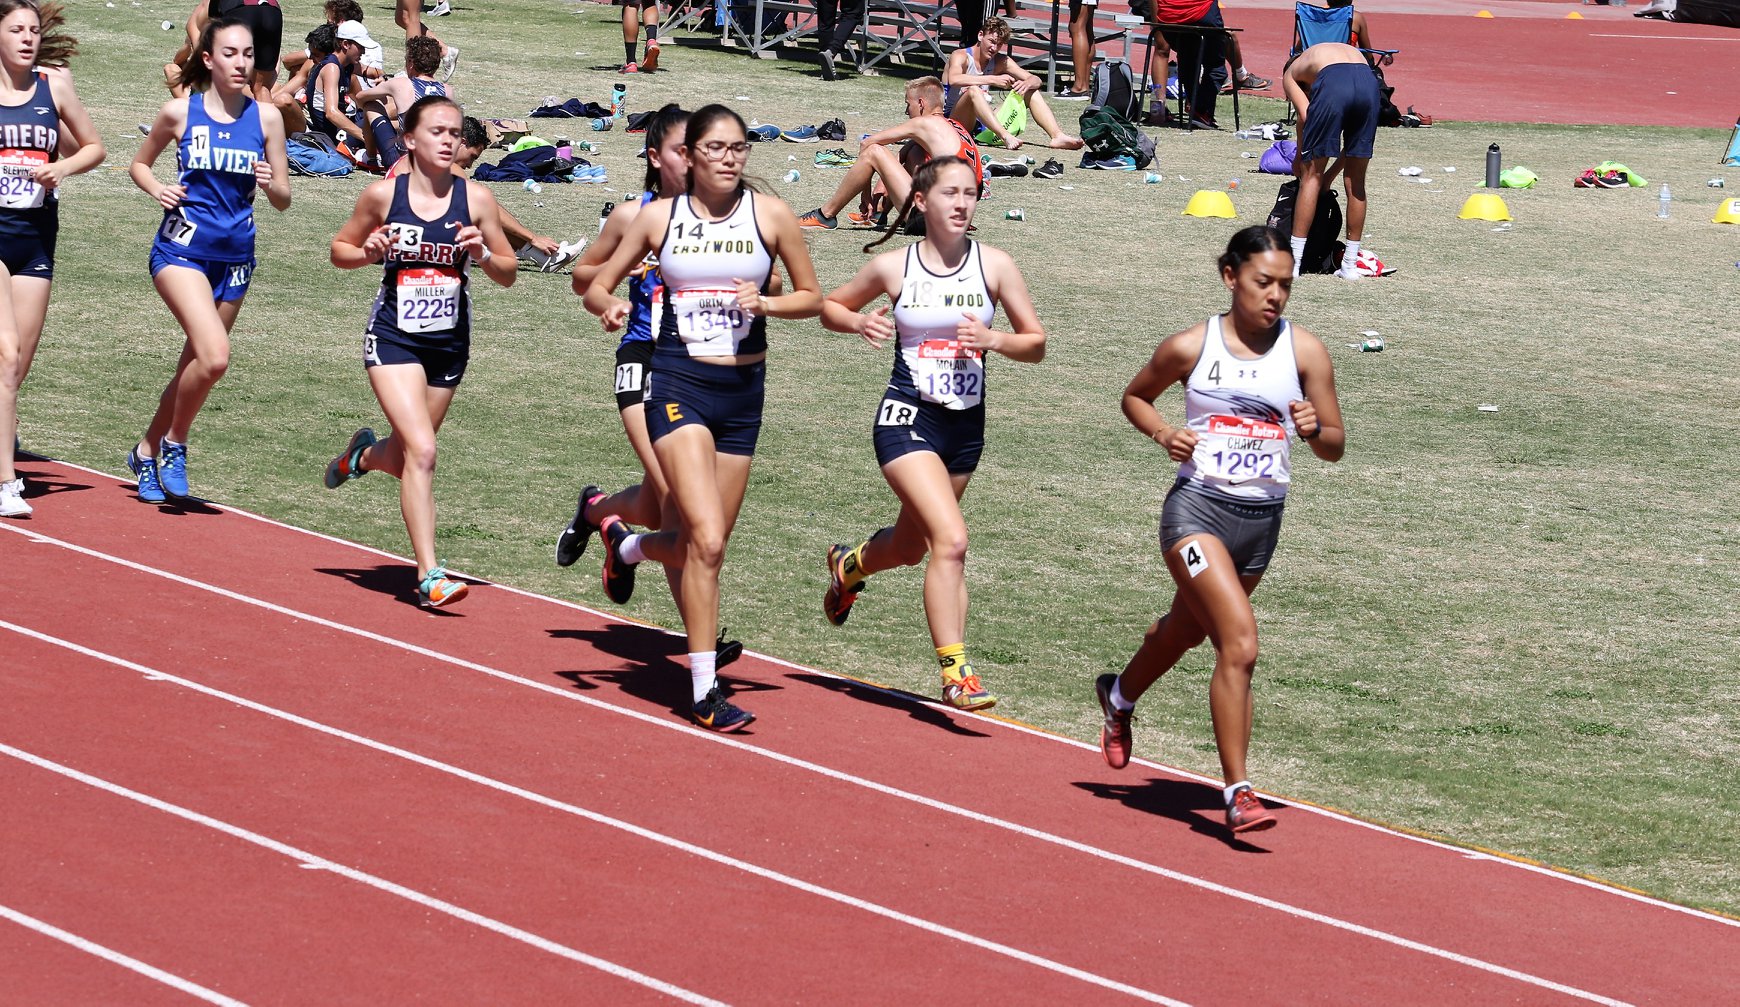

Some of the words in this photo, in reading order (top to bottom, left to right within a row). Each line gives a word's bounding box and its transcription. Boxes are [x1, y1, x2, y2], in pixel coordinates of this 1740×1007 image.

[194, 134, 207, 150] 17
[0, 176, 35, 196] 824
[168, 218, 193, 239] 17
[674, 222, 704, 240] 14
[414, 286, 445, 297] MILLER
[403, 297, 456, 320] 2225
[618, 365, 633, 391] 21
[1208, 360, 1222, 386] 4
[926, 372, 979, 396] 1332
[666, 403, 684, 423] E
[885, 403, 912, 426] 18
[1227, 436, 1264, 451] CHAVEZ
[1212, 450, 1274, 479] 1292
[1188, 546, 1201, 567] 4
